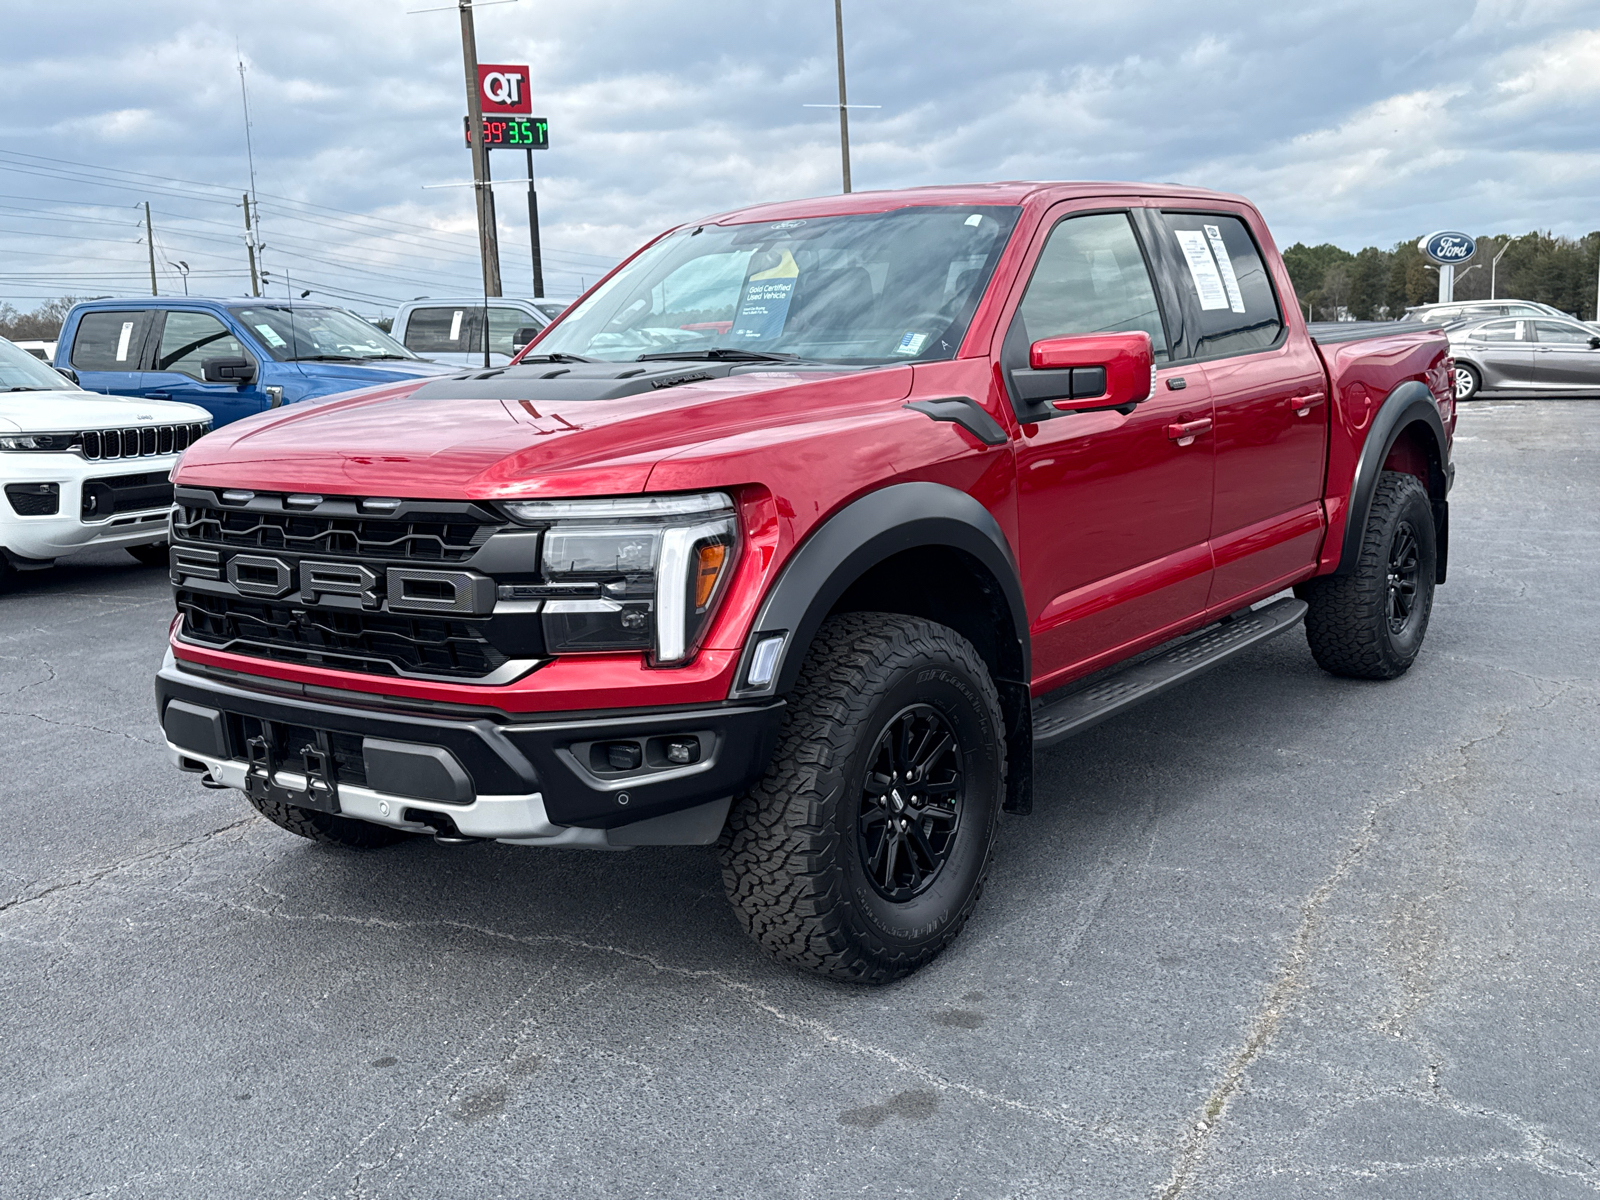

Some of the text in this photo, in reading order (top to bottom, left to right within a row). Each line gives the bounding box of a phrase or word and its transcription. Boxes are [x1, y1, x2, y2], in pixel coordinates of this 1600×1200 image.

[483, 72, 522, 105] QT
[1437, 236, 1468, 257] Ford
[747, 292, 786, 301] Used Vehicle
[749, 283, 792, 294] Gold Certified
[169, 545, 494, 618] FORD
